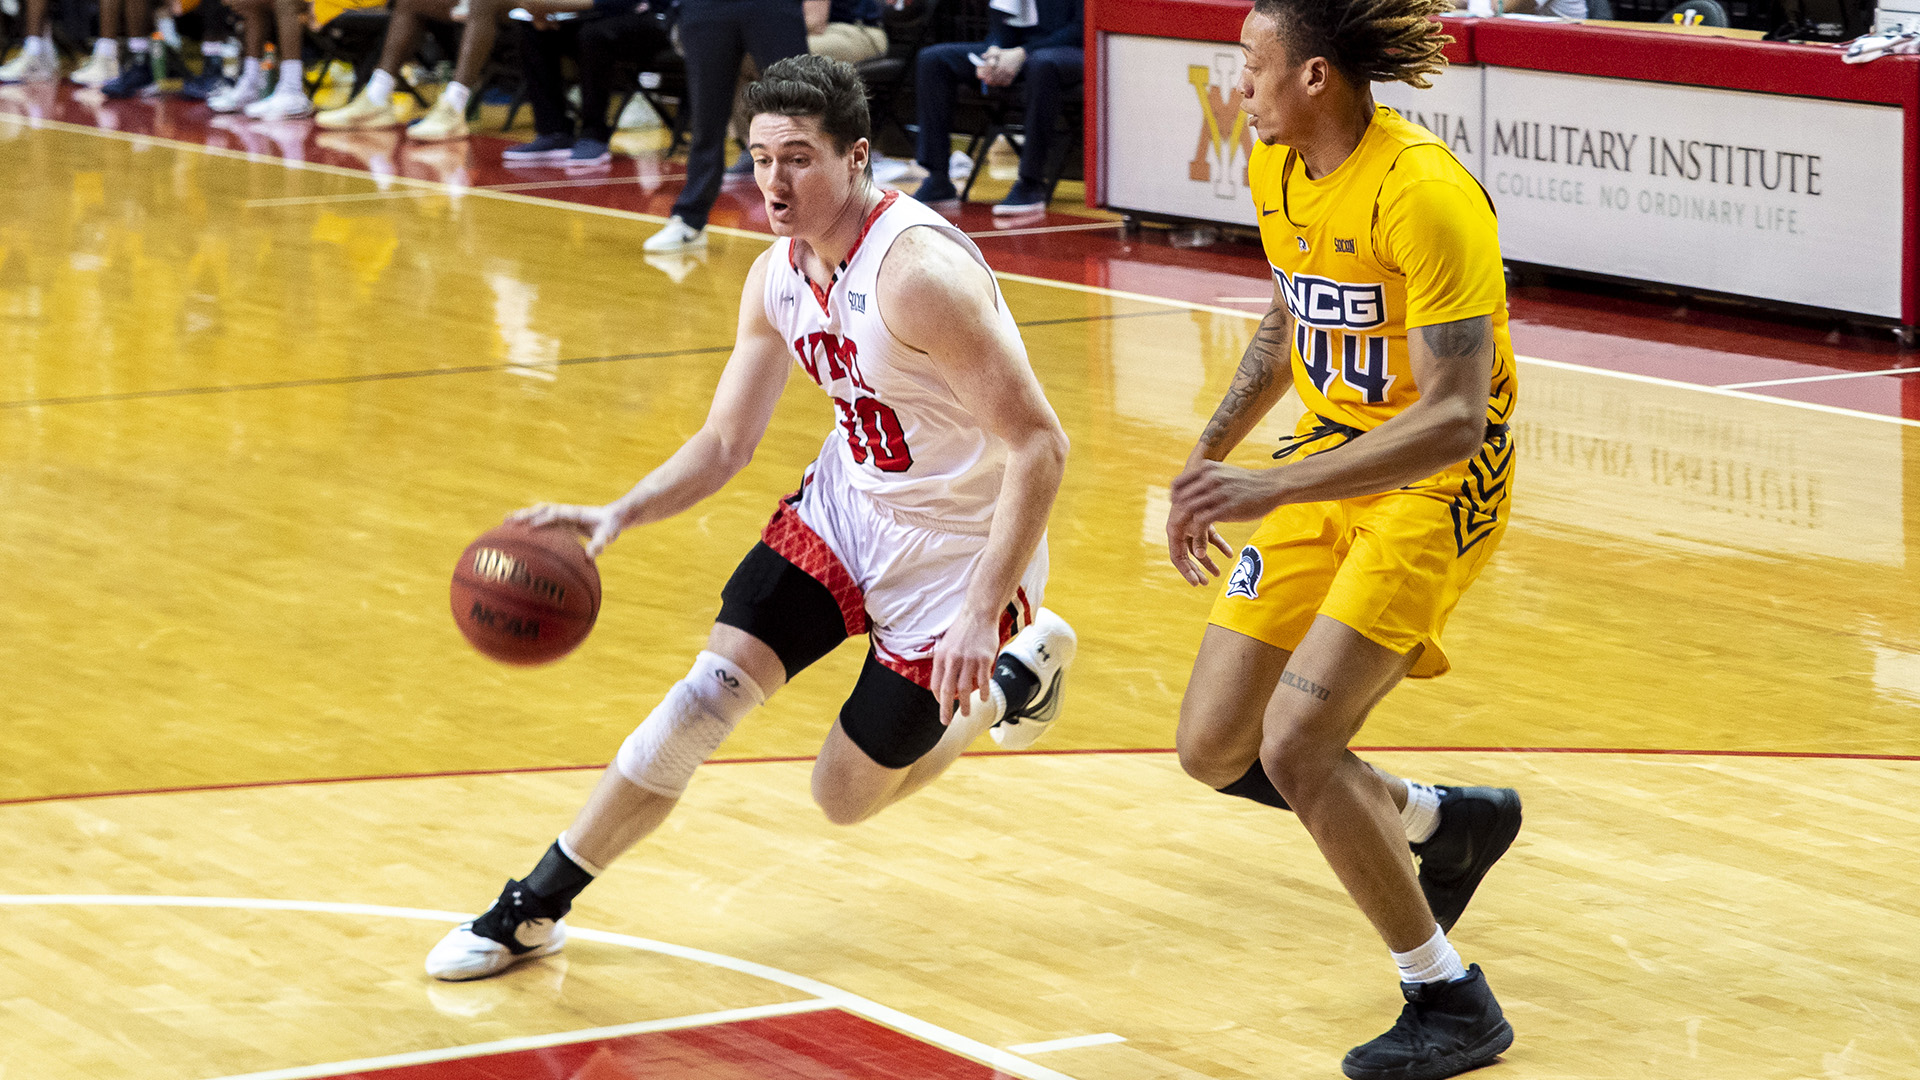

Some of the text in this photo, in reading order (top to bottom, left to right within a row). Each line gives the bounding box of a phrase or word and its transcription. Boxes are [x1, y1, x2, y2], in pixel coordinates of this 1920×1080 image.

[1493, 119, 1637, 172] MILITARY
[1650, 135, 1822, 196] INSTITUTE
[1600, 185, 1629, 211] NO
[1637, 189, 1746, 227] ORDINARY
[1272, 264, 1387, 331] NCG
[1294, 322, 1397, 404] 44
